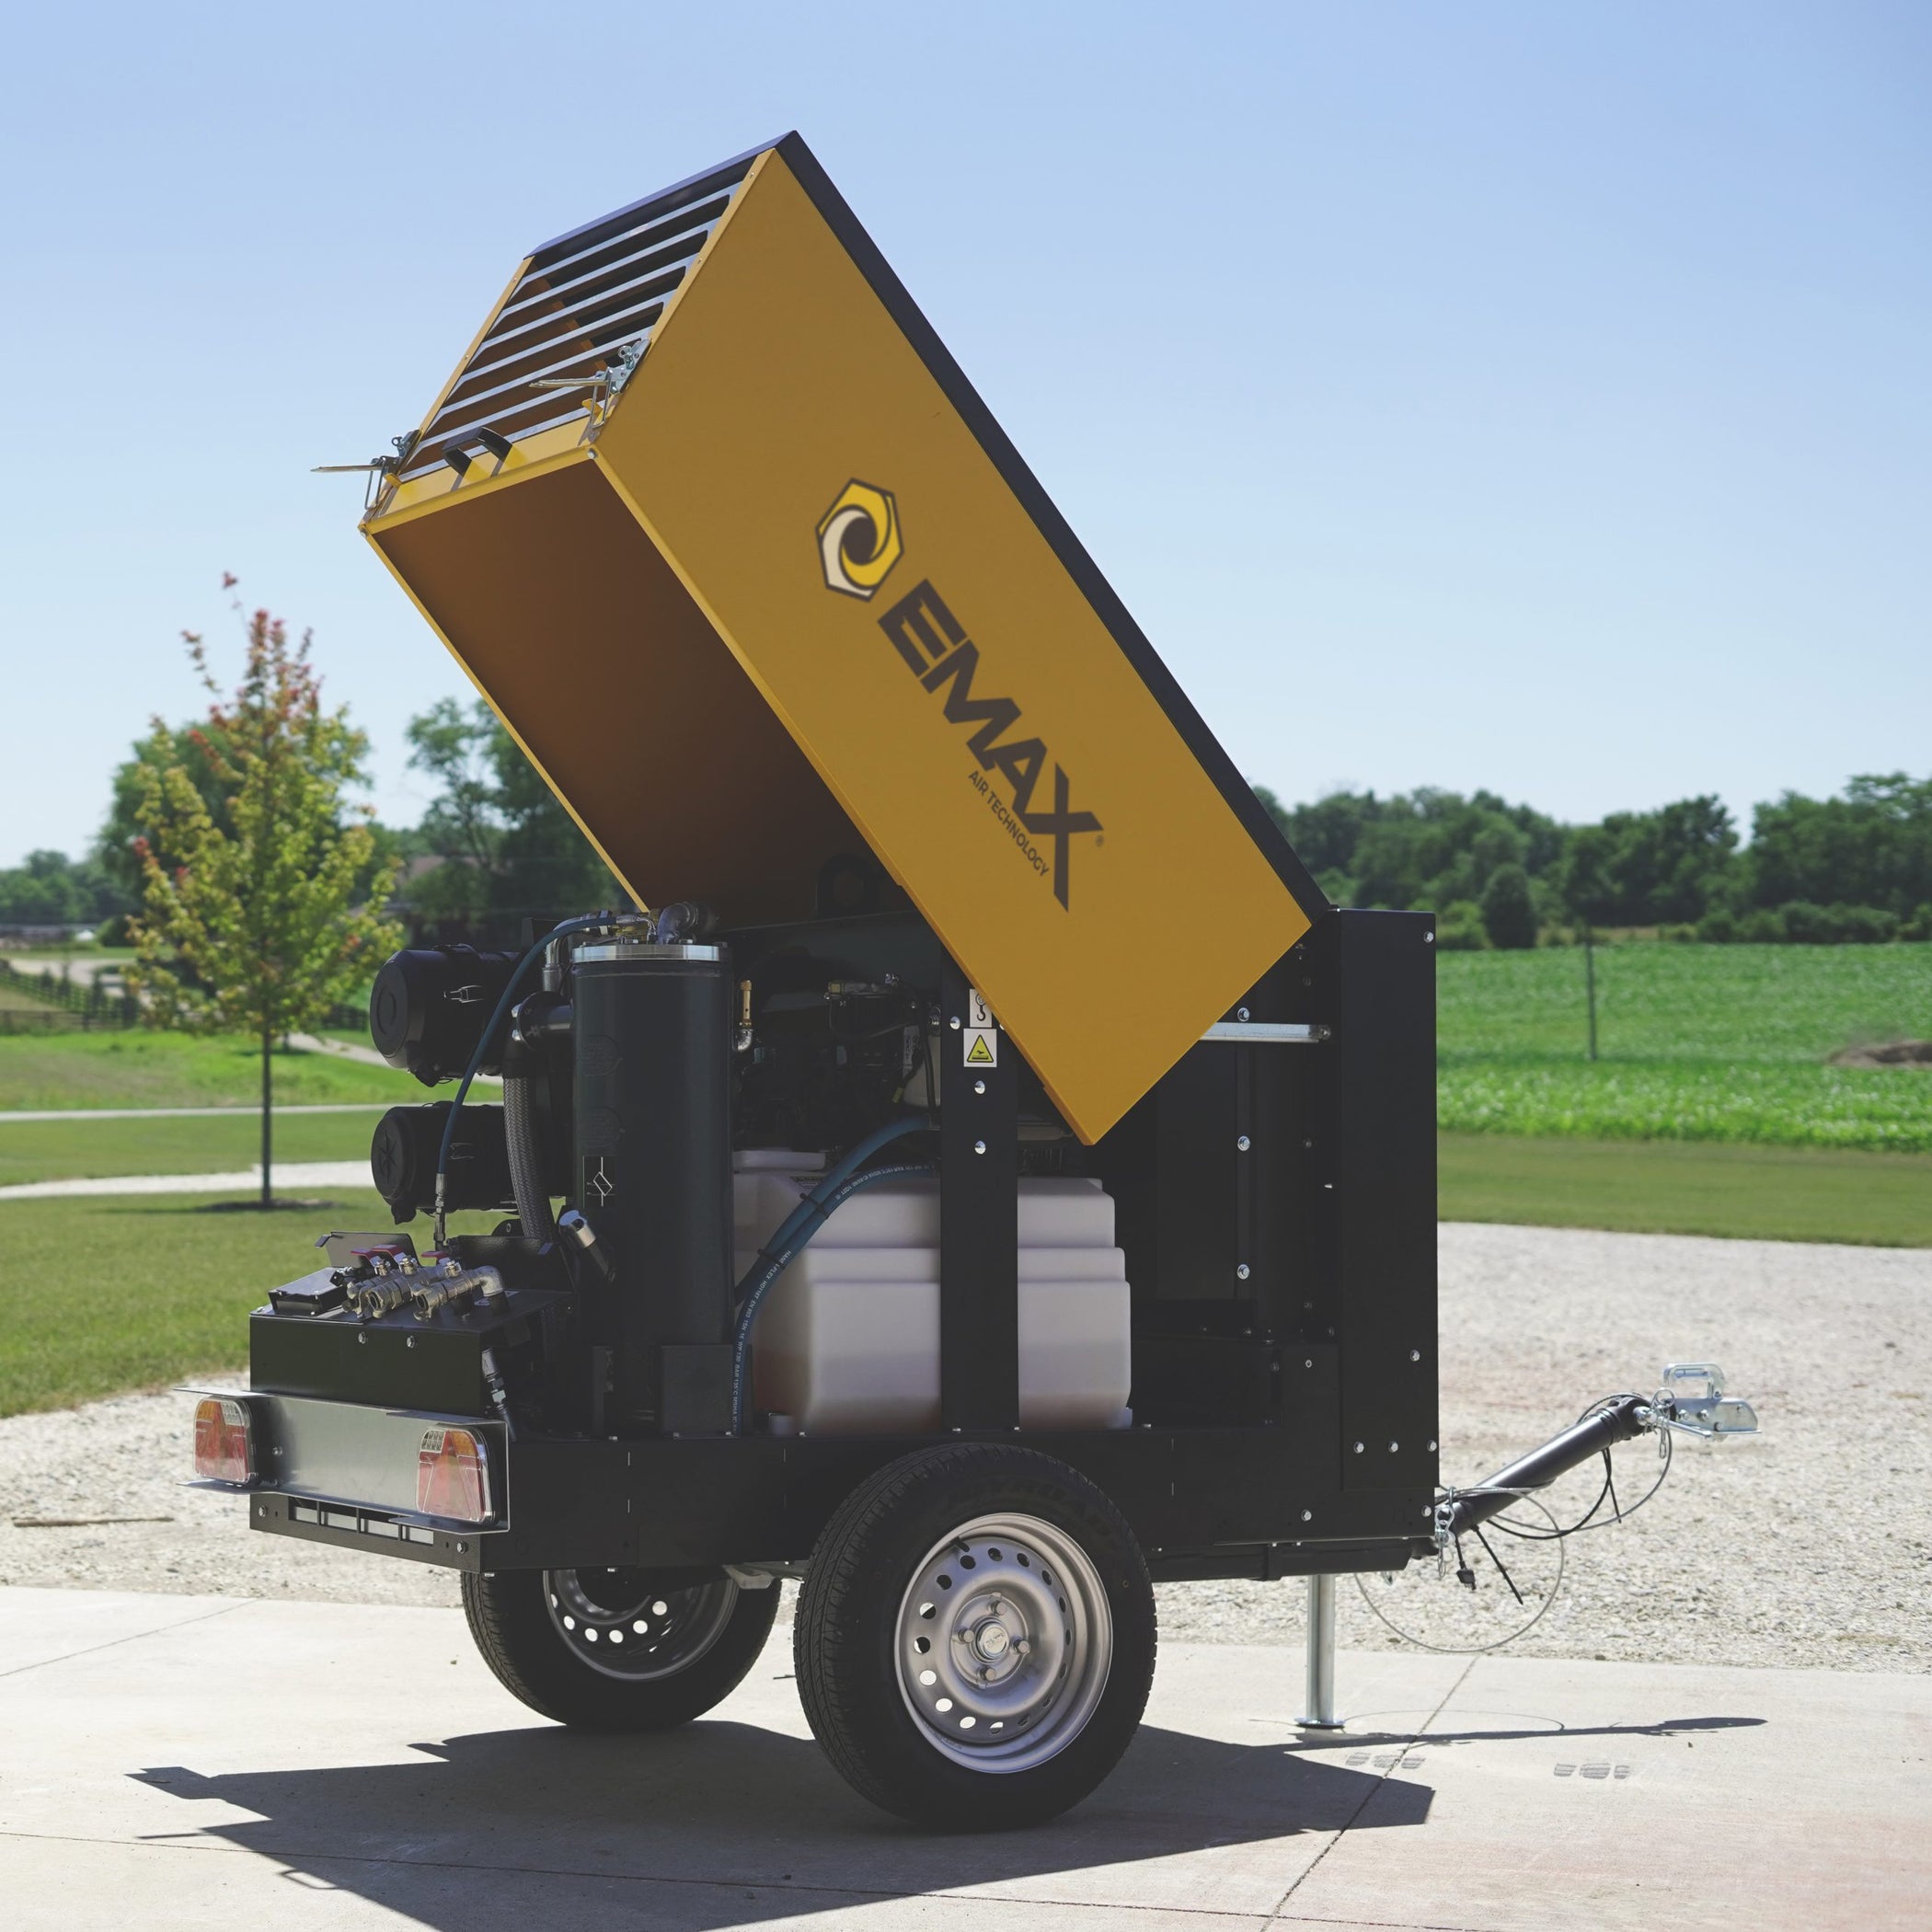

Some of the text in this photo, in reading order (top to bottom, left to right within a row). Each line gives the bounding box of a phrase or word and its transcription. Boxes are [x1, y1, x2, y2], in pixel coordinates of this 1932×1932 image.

[877, 578, 1104, 914] EMAX
[968, 770, 1050, 877] AIR TECHNOLOGY
